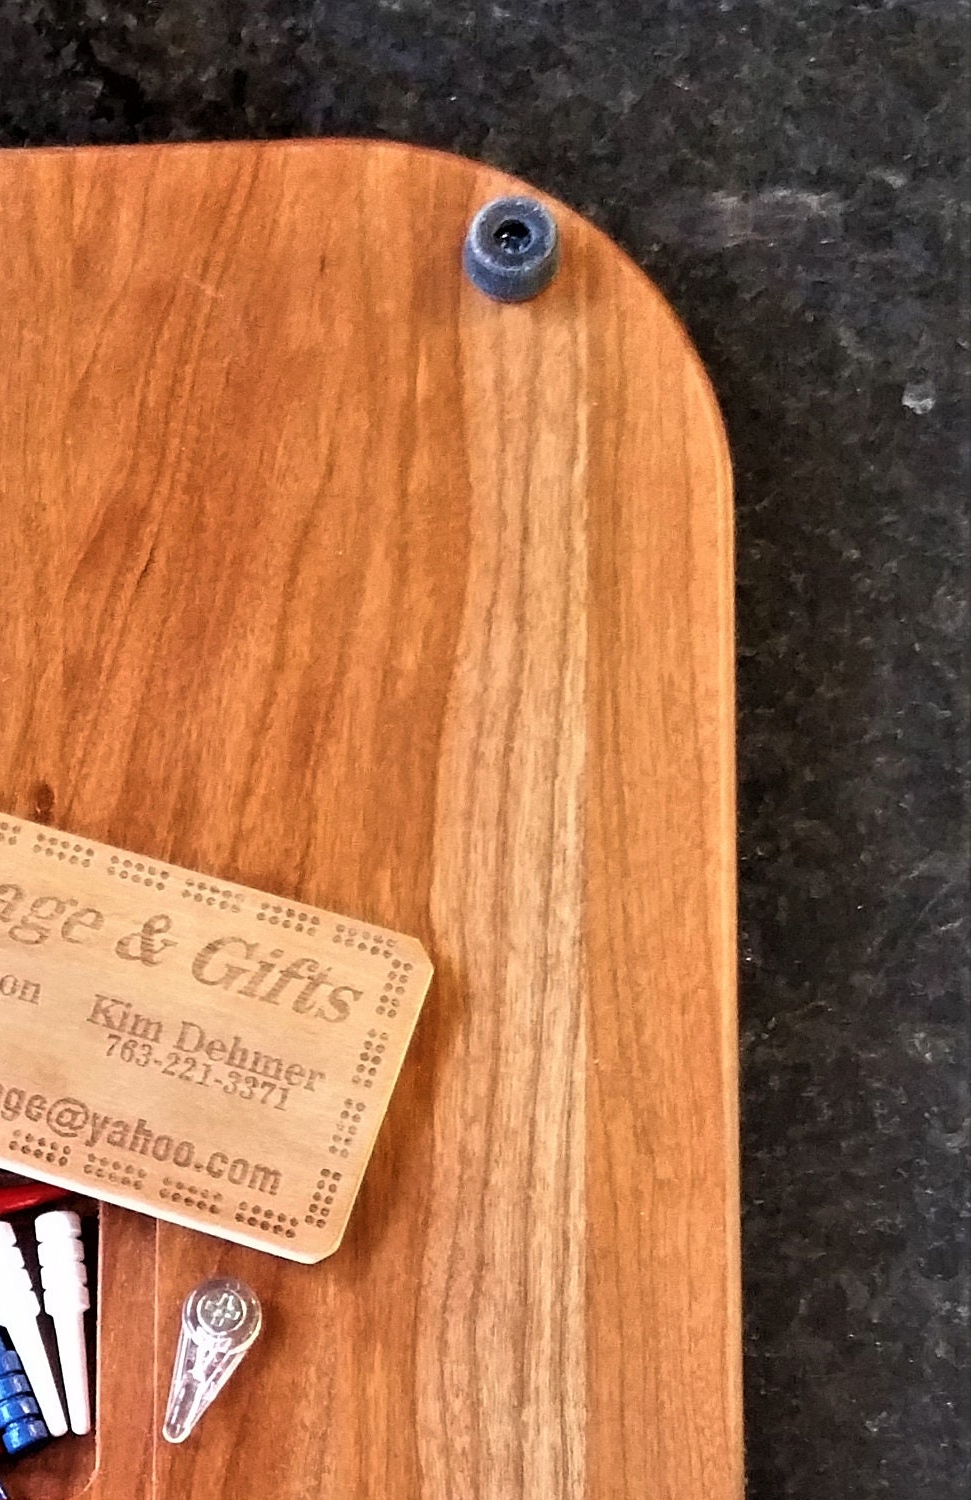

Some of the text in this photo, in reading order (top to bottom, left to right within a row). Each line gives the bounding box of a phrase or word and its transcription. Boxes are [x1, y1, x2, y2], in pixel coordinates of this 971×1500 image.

[117, 912, 178, 967] &
[192, 935, 364, 1025] Gifts
[86, 994, 325, 1092] Kim Dehmer
[106, 1034, 289, 1112] 763-221-3371
